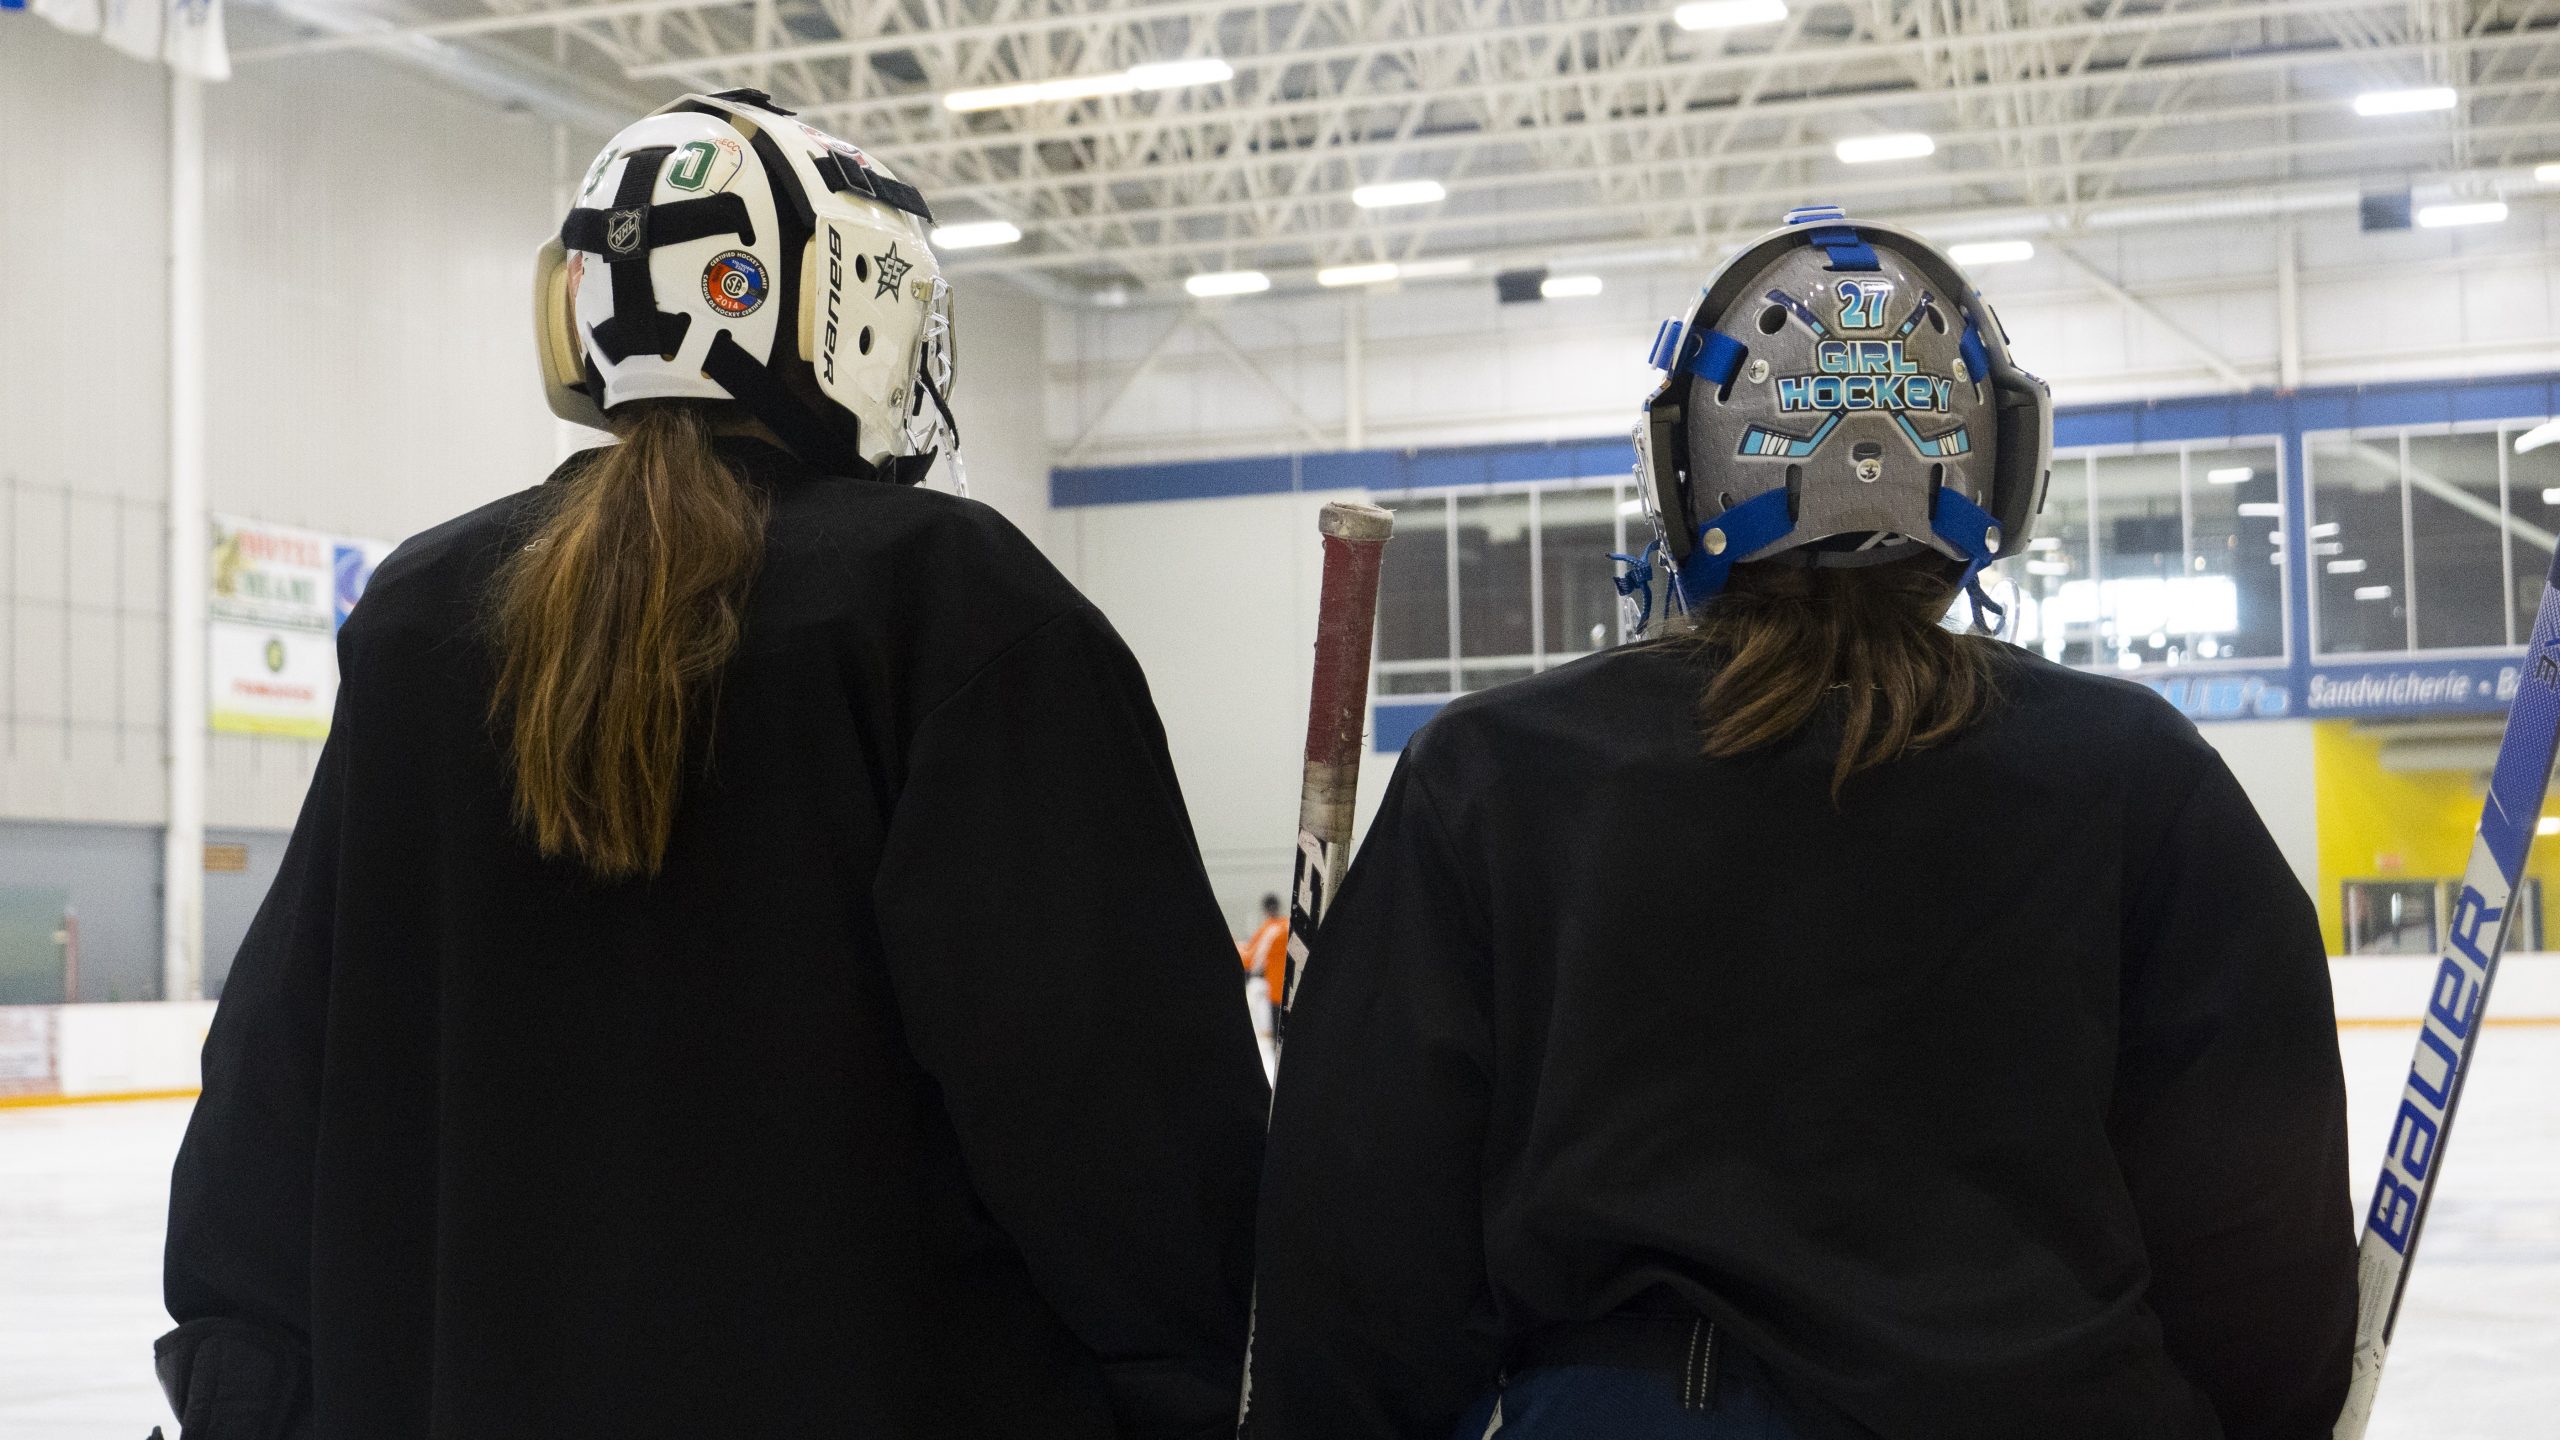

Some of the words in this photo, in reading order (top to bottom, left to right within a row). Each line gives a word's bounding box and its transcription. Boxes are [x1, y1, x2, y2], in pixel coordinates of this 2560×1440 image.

[614, 216, 636, 244] NHL
[710, 252, 736, 267] CERTIFIED
[737, 252, 760, 267] HOCKEY
[758, 267, 768, 290] HELMET
[708, 299, 716, 308] DE
[715, 306, 740, 317] HOCKEY
[716, 295, 739, 309] 2014
[823, 224, 842, 386] BAUER
[1836, 279, 1891, 329] 27
[1817, 339, 1918, 374] GIRL
[1777, 374, 1952, 412] HOCKEY
[2308, 669, 2471, 709] Sandwicherie
[2367, 884, 2503, 1256] BAUER
